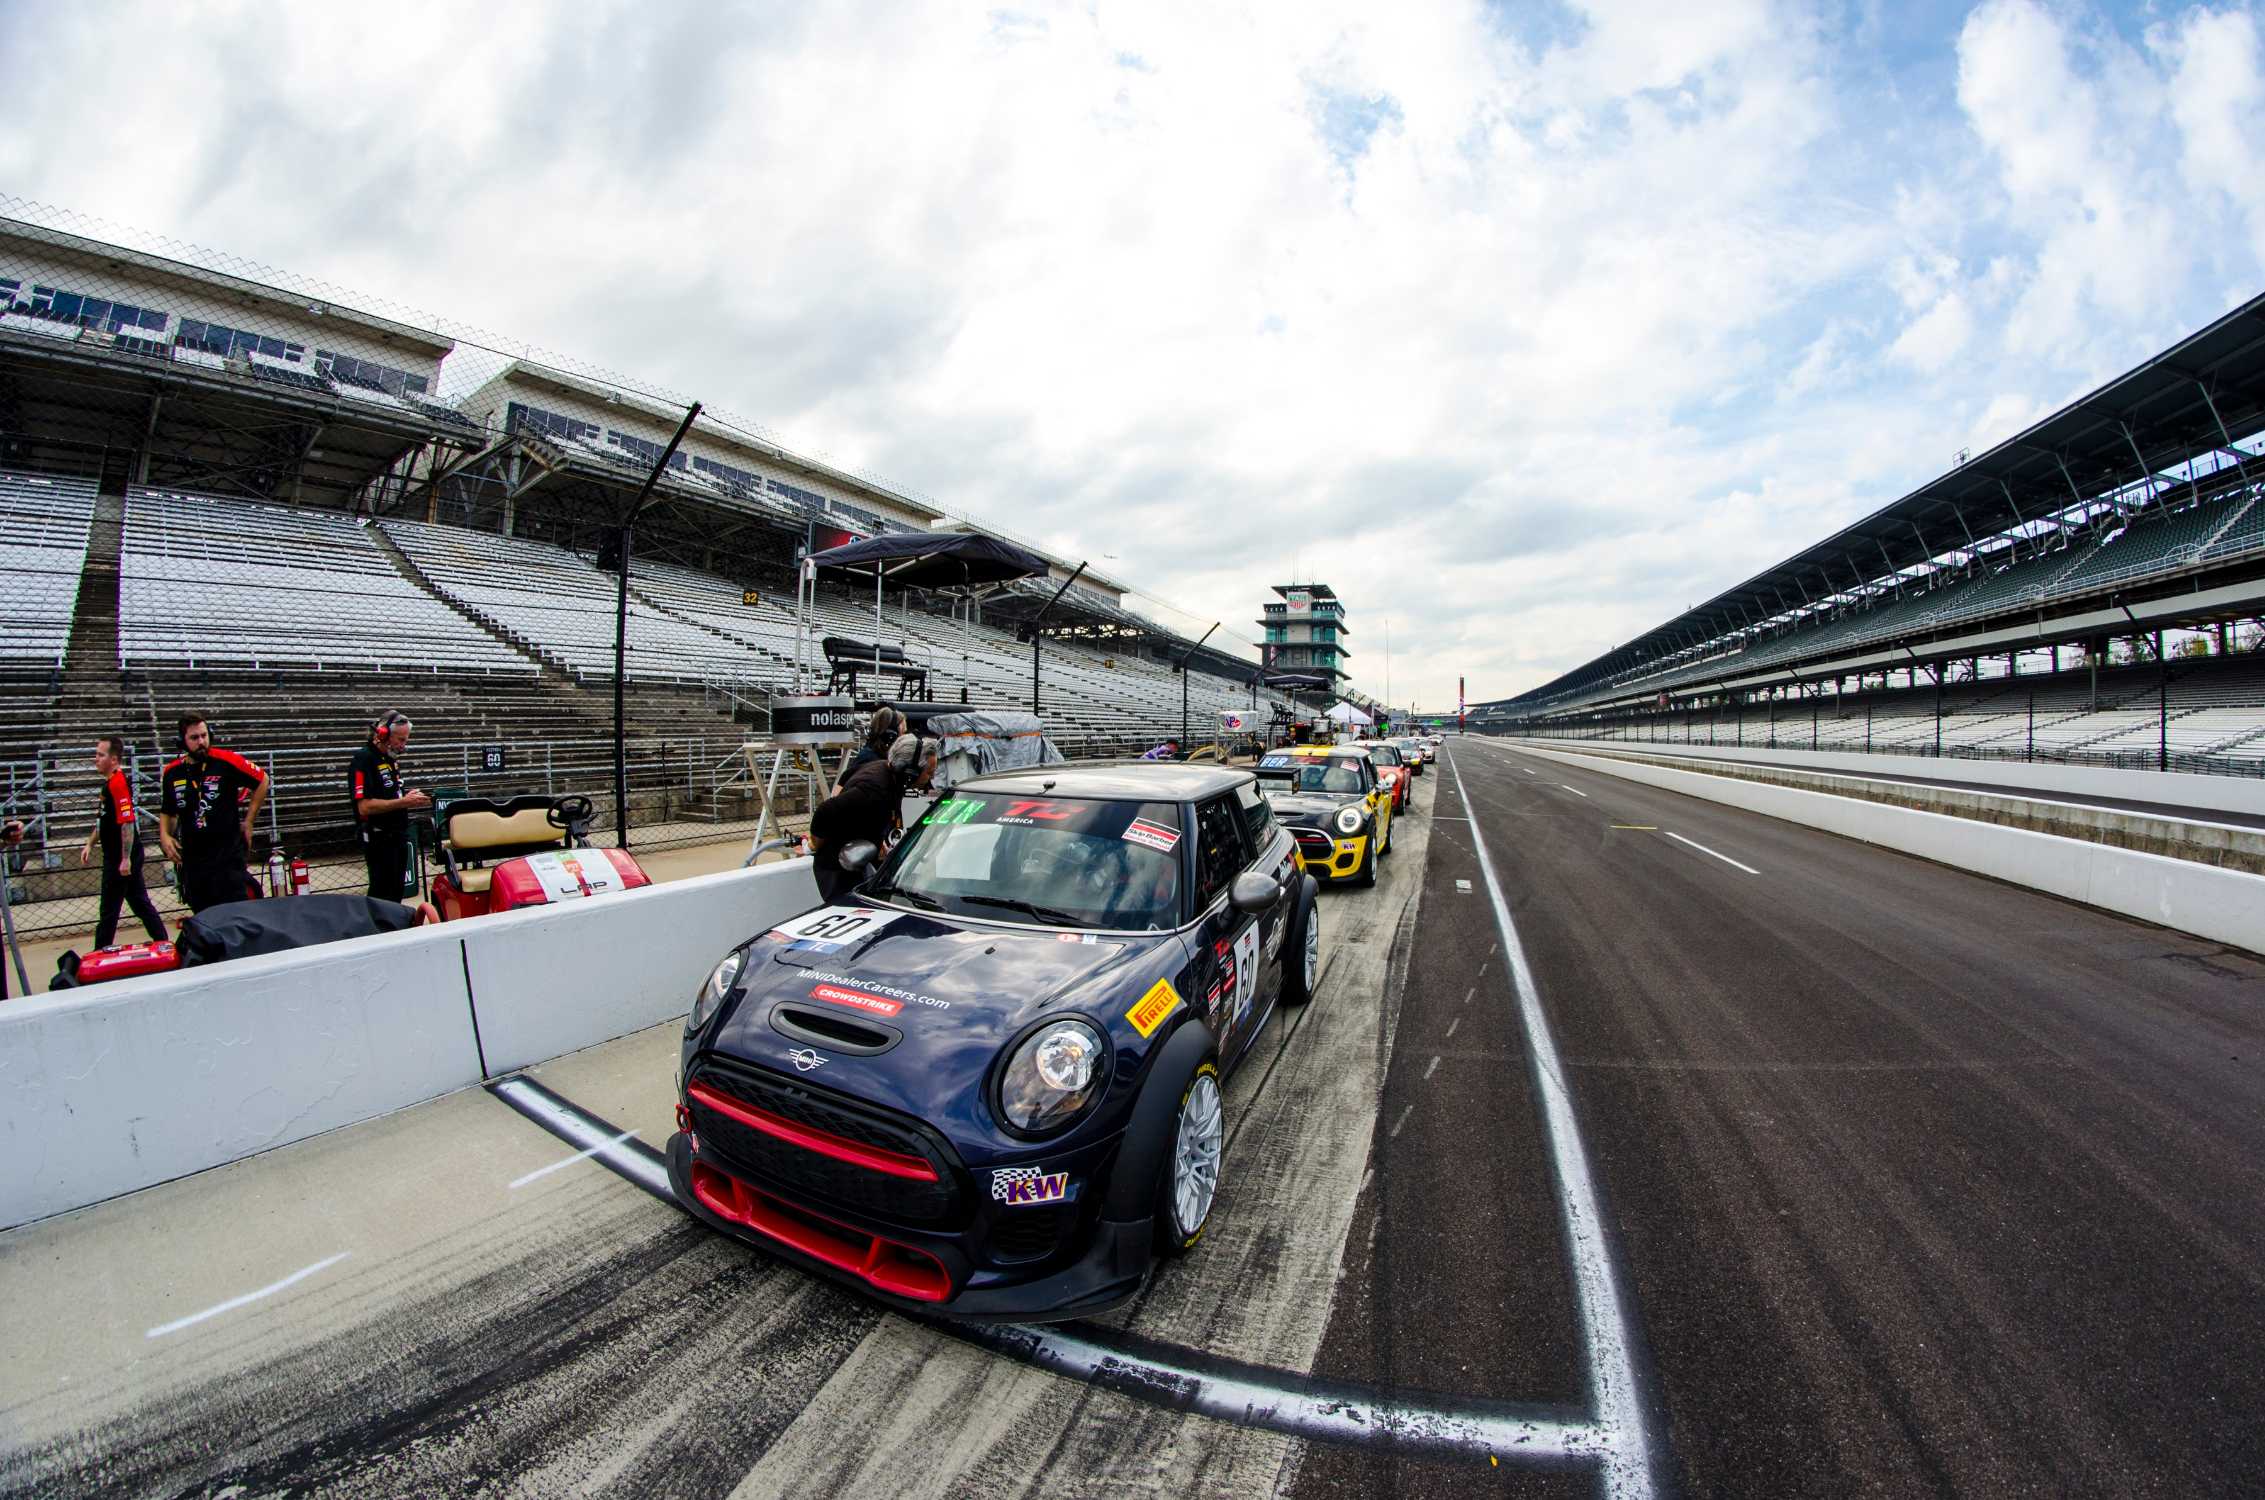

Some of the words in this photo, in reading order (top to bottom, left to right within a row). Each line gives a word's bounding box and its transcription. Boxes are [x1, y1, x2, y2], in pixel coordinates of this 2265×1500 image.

[744, 592, 758, 603] 32
[487, 753, 500, 767] 60
[996, 816, 1034, 825] AMERICA
[560, 881, 608, 894] LAP
[798, 915, 871, 939] 60
[809, 942, 832, 951] TC
[797, 969, 951, 1010] MINIDealerCareers.com
[1238, 949, 1254, 1011] 60
[819, 988, 896, 1012] CROWDSTRIKE
[1133, 985, 1174, 1030] PIRELLI
[799, 1055, 814, 1065] MINI
[1007, 1173, 1068, 1204] KW
